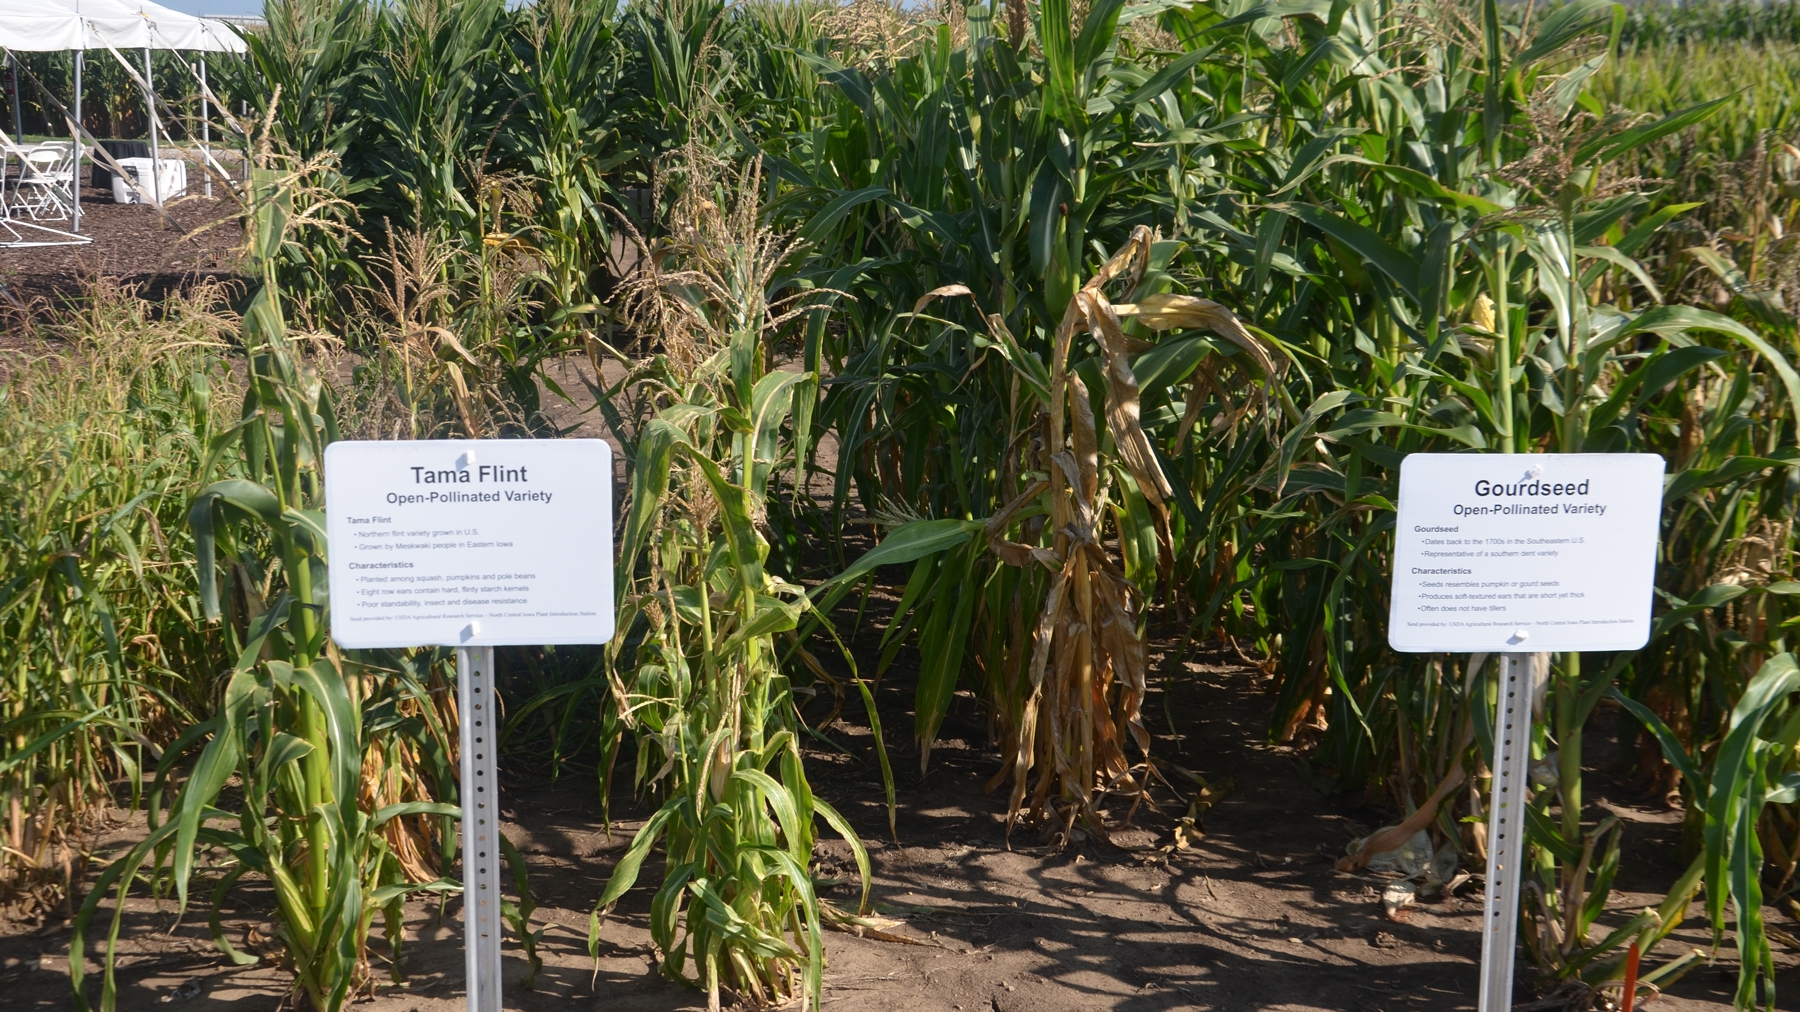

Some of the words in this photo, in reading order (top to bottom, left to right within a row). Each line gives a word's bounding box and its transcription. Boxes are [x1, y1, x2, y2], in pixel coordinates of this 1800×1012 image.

[411, 467, 470, 483] Tama
[479, 466, 527, 482] Flint
[1475, 479, 1589, 496] Gourdseed
[386, 491, 500, 506] Open-Pollinated
[505, 490, 552, 503] Variety
[1454, 504, 1558, 517] Open-Pollinated
[1563, 503, 1607, 516] Variety
